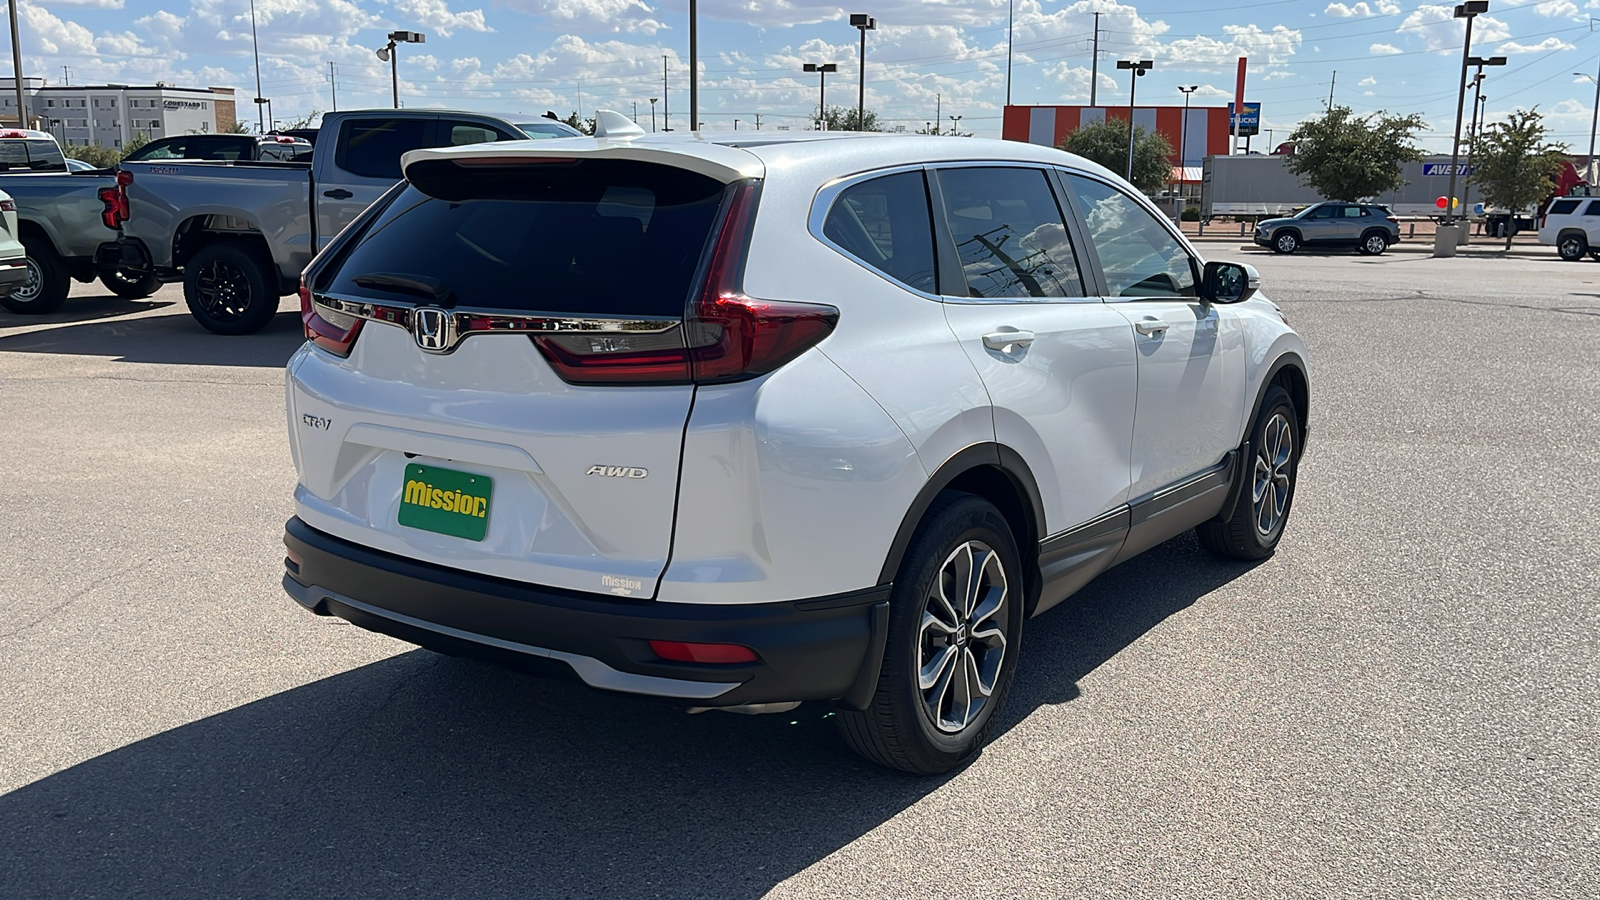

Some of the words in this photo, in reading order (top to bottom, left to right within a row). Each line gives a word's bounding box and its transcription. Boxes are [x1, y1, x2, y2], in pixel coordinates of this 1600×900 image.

[163, 100, 201, 108] COURTYARD
[585, 464, 649, 479] AWD
[404, 479, 487, 518] Mission
[602, 575, 641, 590] Mission
